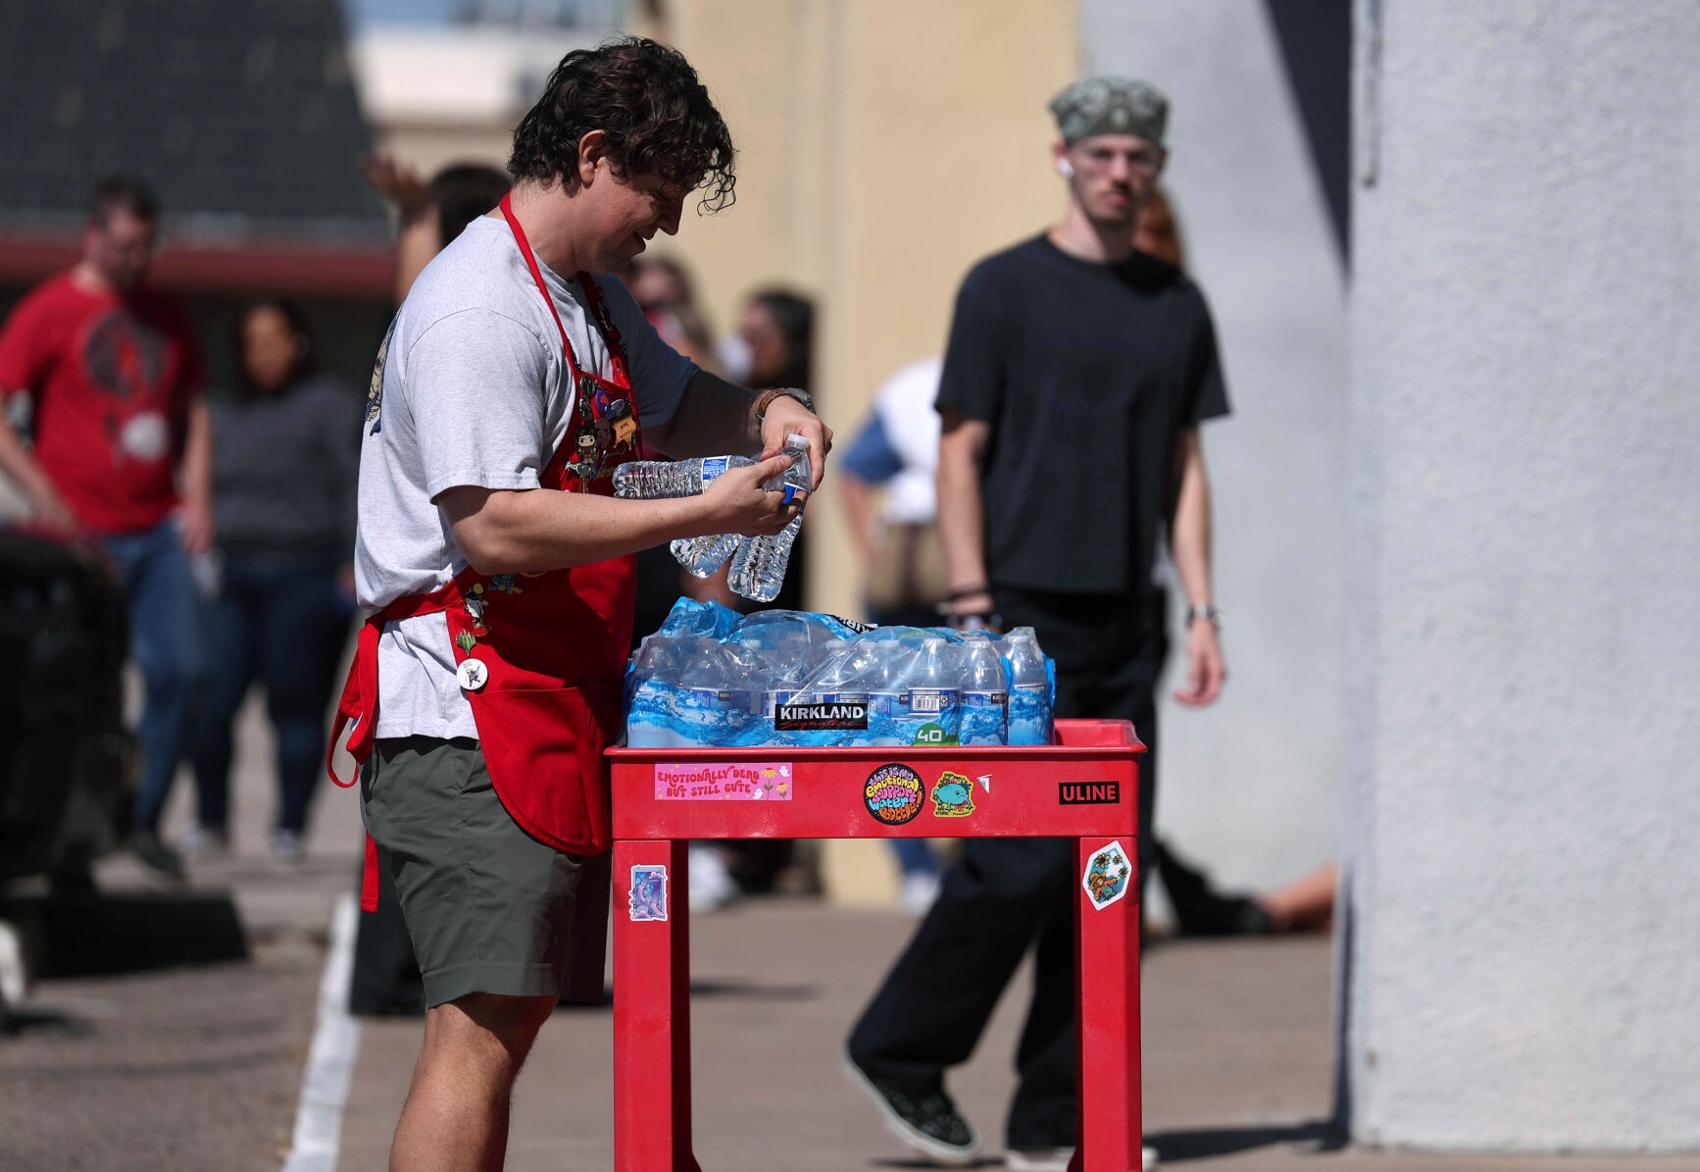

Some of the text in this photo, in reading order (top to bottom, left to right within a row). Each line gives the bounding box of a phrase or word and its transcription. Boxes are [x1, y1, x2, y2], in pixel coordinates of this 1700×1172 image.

[780, 706, 864, 720] KIRKLAND
[917, 729, 942, 742] 40
[657, 765, 760, 788] EMOTIONALLY DEAD
[666, 780, 751, 797] BUT STILL CUTE
[866, 775, 919, 797] emotional
[872, 785, 917, 803] support
[1063, 784, 1116, 801] ULINE
[868, 797, 909, 810] water
